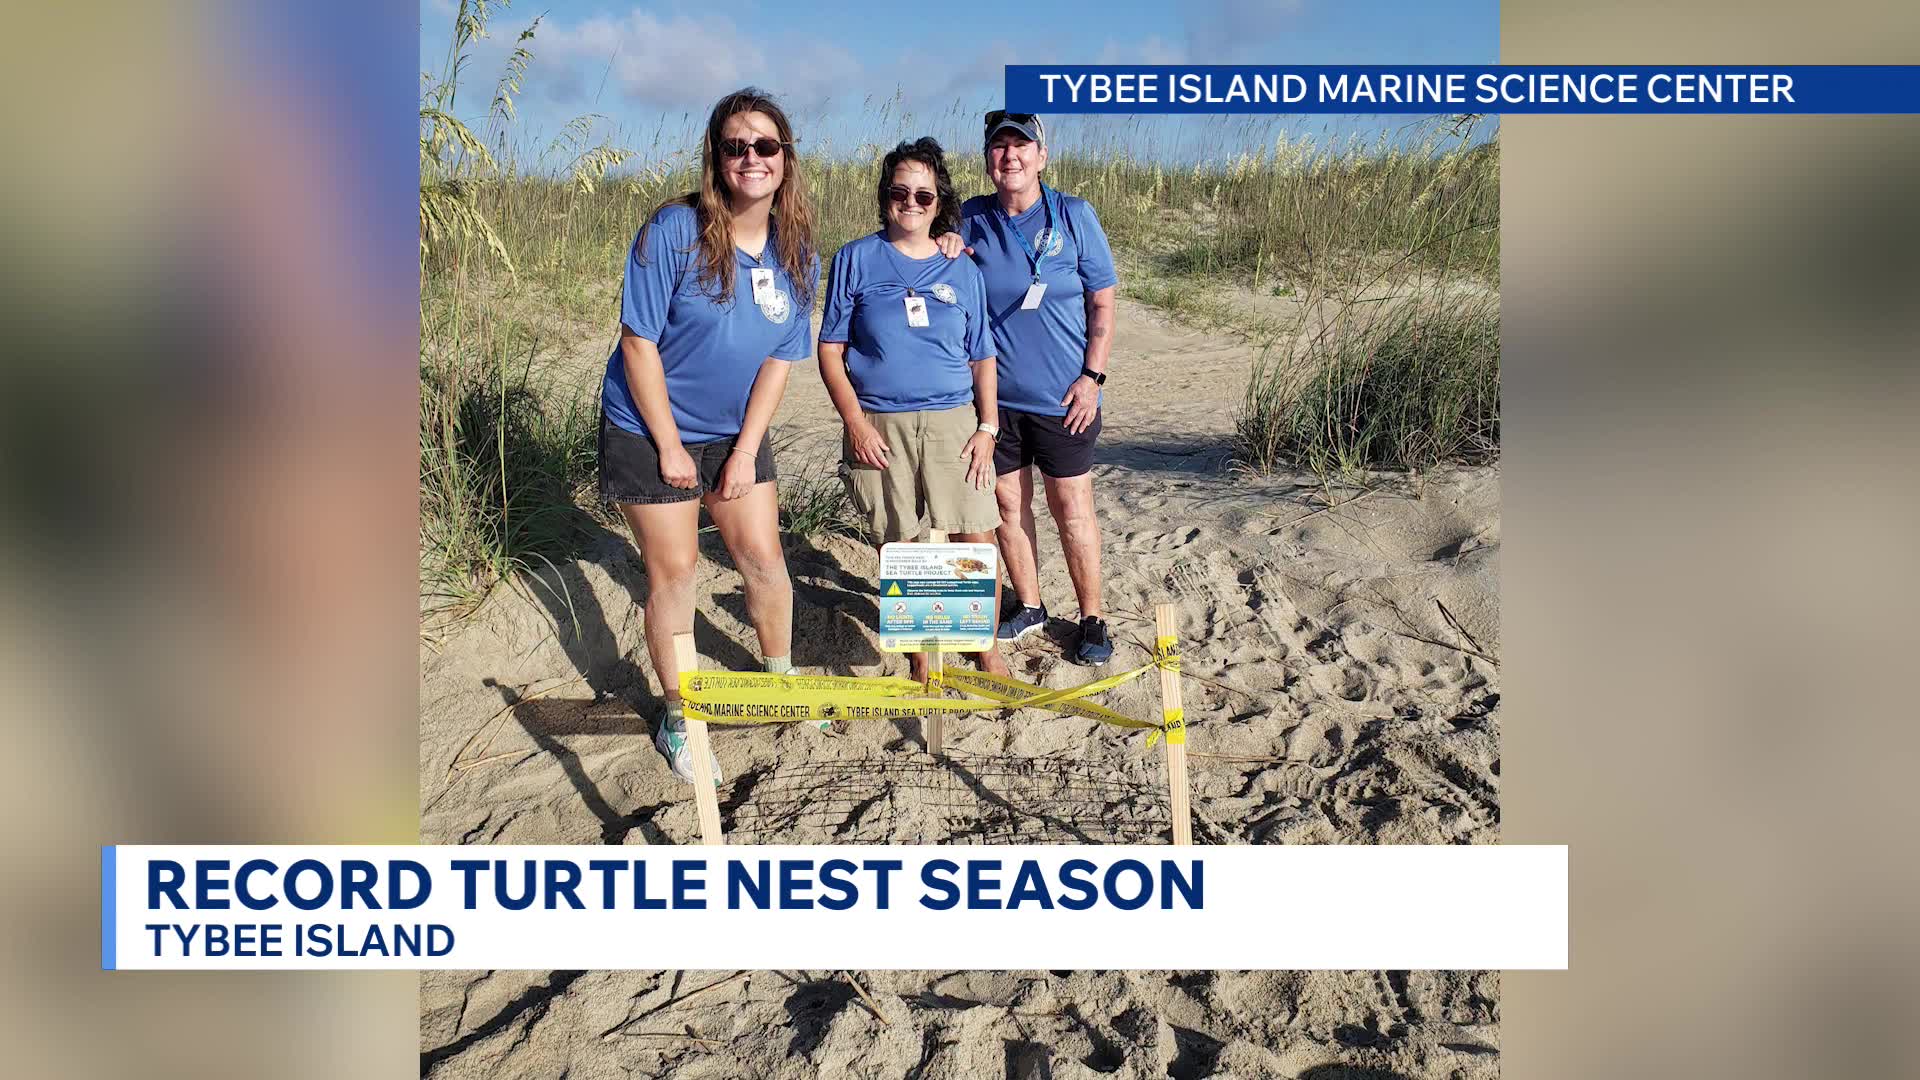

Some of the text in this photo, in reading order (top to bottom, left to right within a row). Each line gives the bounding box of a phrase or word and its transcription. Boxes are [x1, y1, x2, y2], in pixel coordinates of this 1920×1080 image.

[714, 703, 744, 717] MARINE
[746, 704, 778, 718] SCIENCE
[780, 704, 810, 718] CENTER
[846, 706, 870, 717] TYBEE
[872, 707, 900, 717] ISLAND
[902, 708, 916, 716] SEA
